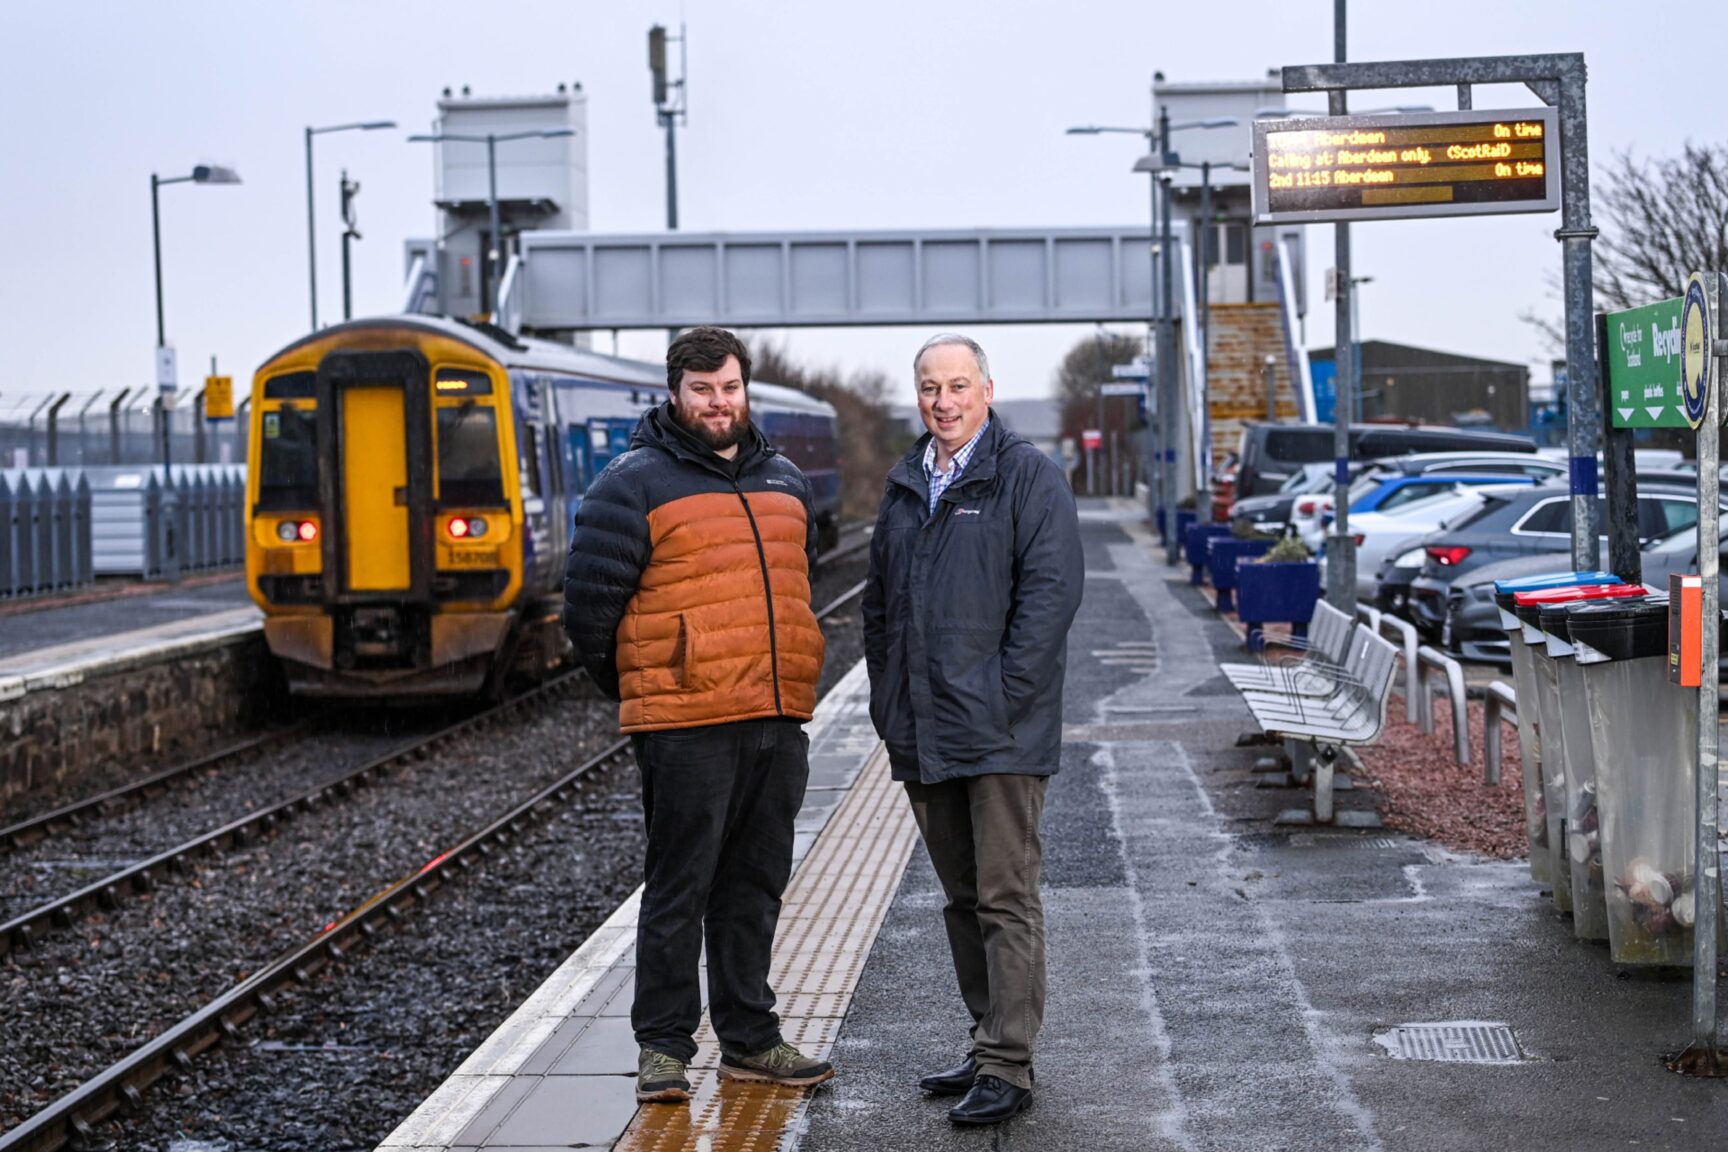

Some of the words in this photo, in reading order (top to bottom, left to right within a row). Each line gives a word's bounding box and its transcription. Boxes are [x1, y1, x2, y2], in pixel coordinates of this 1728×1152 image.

[1314, 130, 1385, 146] Aberdeen
[1494, 124, 1510, 138] On
[1515, 123, 1542, 136] time
[1269, 153, 1311, 169] Calling
[1338, 149, 1397, 164] Aberdeen
[1269, 172, 1292, 188] 2nd
[1296, 170, 1330, 186] 11:15
[1334, 168, 1394, 184] Aberdeen
[1495, 163, 1511, 176] On
[1516, 162, 1543, 175] time
[1652, 316, 1681, 364] Recyclin
